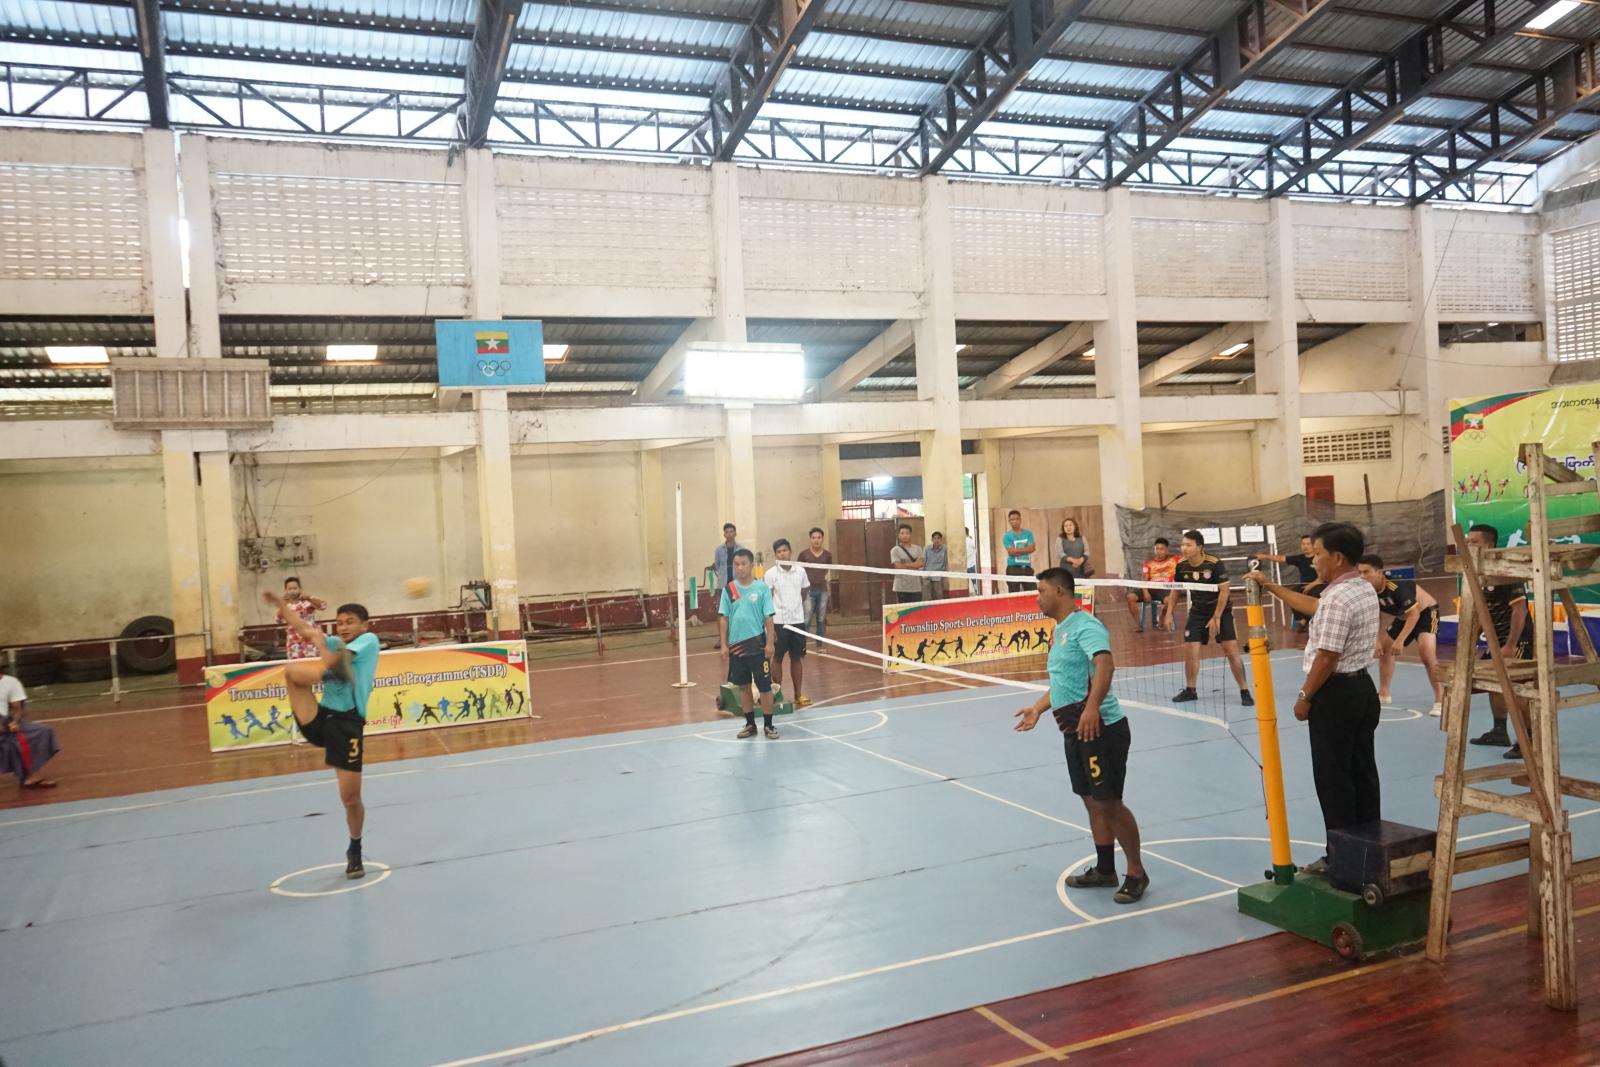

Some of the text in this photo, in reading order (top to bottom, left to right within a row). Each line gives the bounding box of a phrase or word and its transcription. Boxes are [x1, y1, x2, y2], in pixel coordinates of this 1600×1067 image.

[901, 610, 1048, 634] Township Sports Development Program
[763, 660, 770, 673] 8
[229, 682, 288, 702] Township
[405, 663, 507, 686] Programme(TSDP)
[349, 738, 359, 757] 3
[1089, 755, 1101, 778] 5
